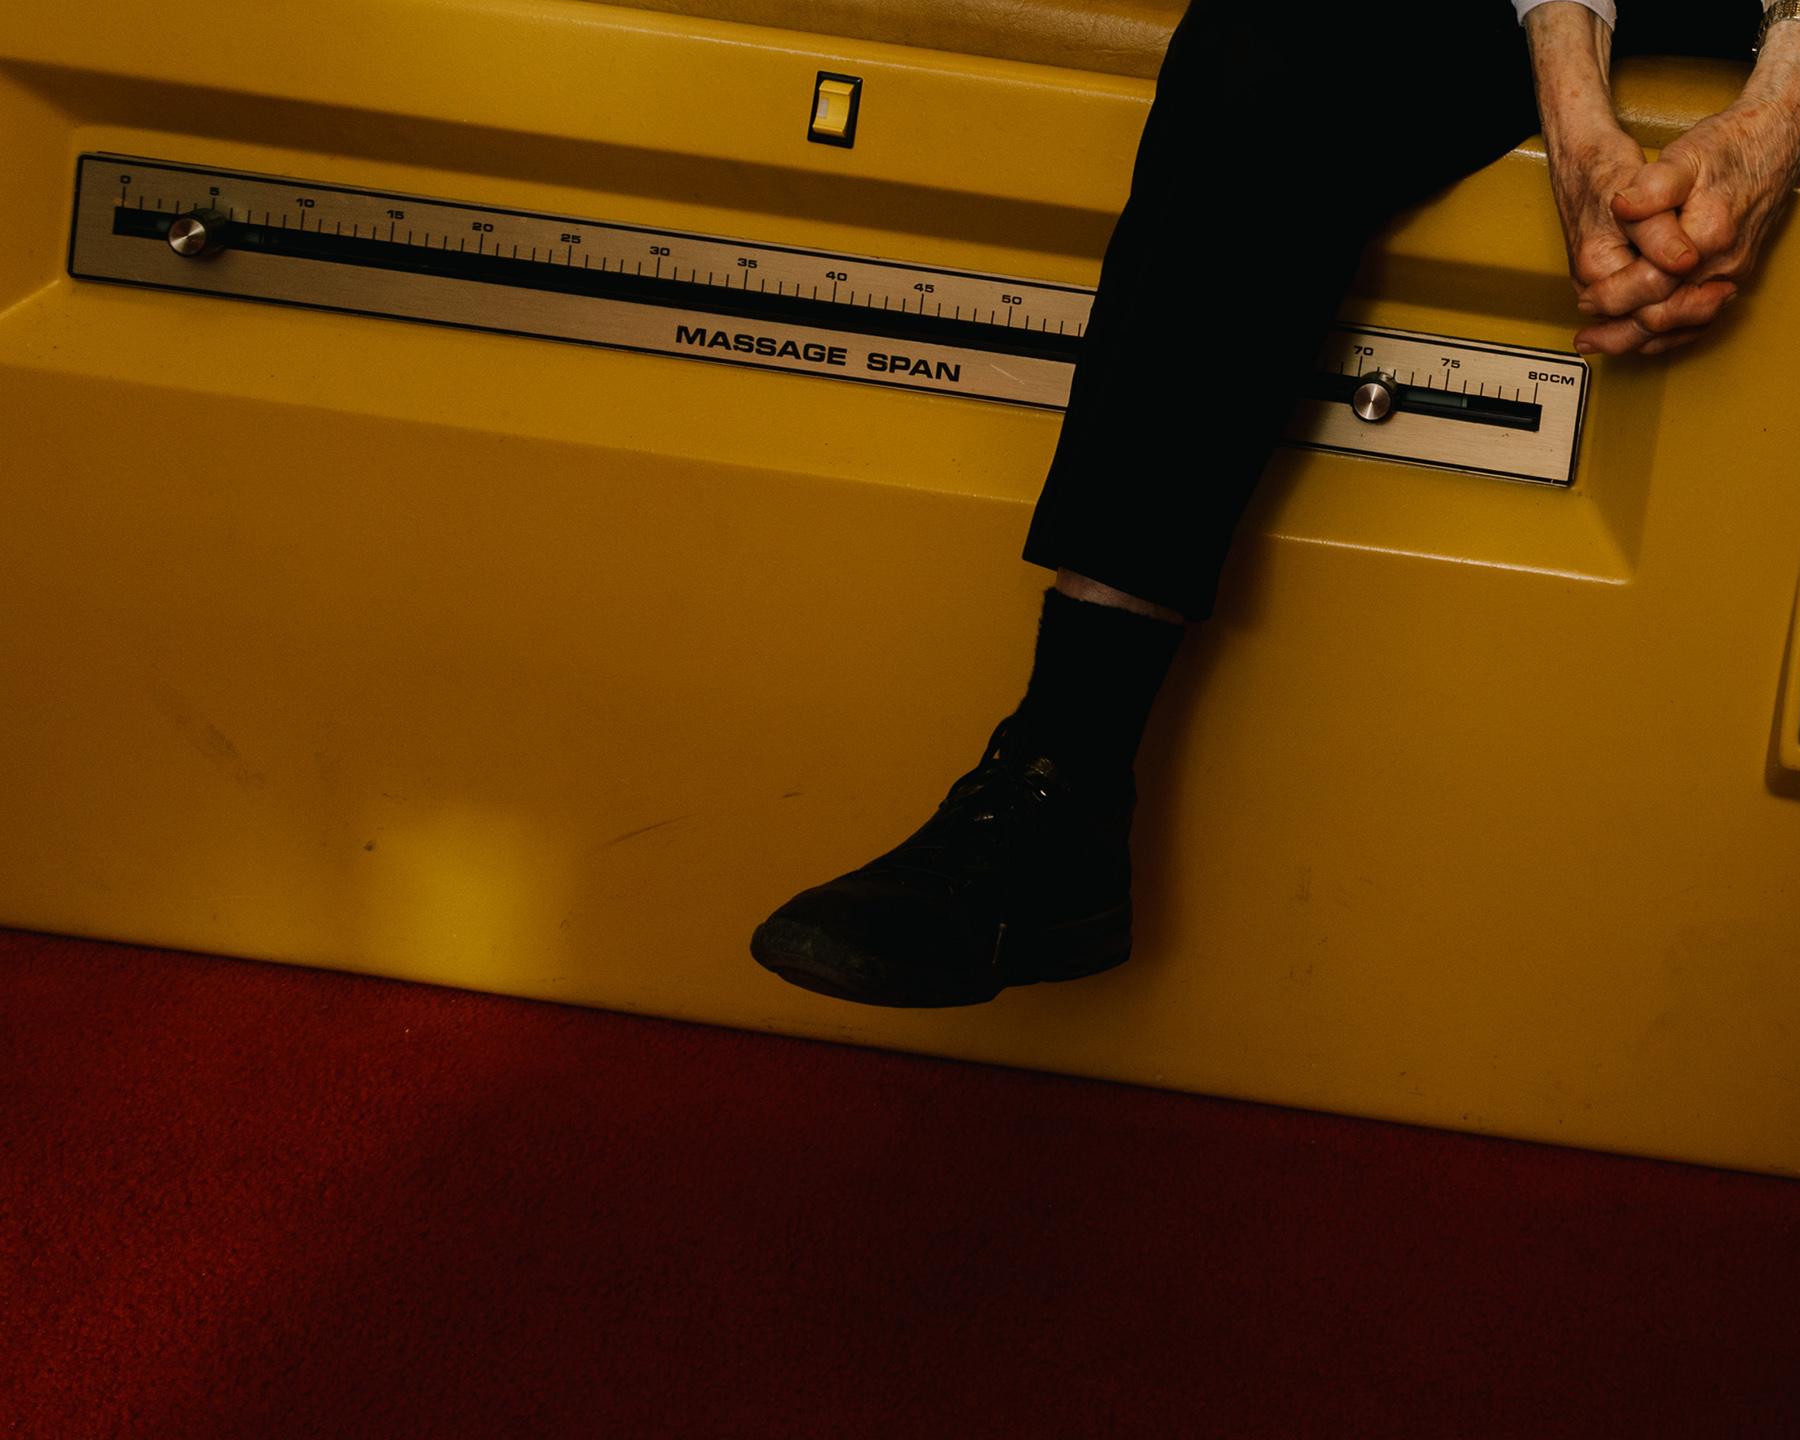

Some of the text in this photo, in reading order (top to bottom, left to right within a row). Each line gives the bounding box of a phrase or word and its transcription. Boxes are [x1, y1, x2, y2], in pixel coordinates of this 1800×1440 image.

[119, 175, 1023, 306] 0 5 10 15 20 25 30 35 40 45 50
[675, 325, 961, 383] MASSAGE SPAN
[1354, 345, 1575, 386] 70 75 80CM
